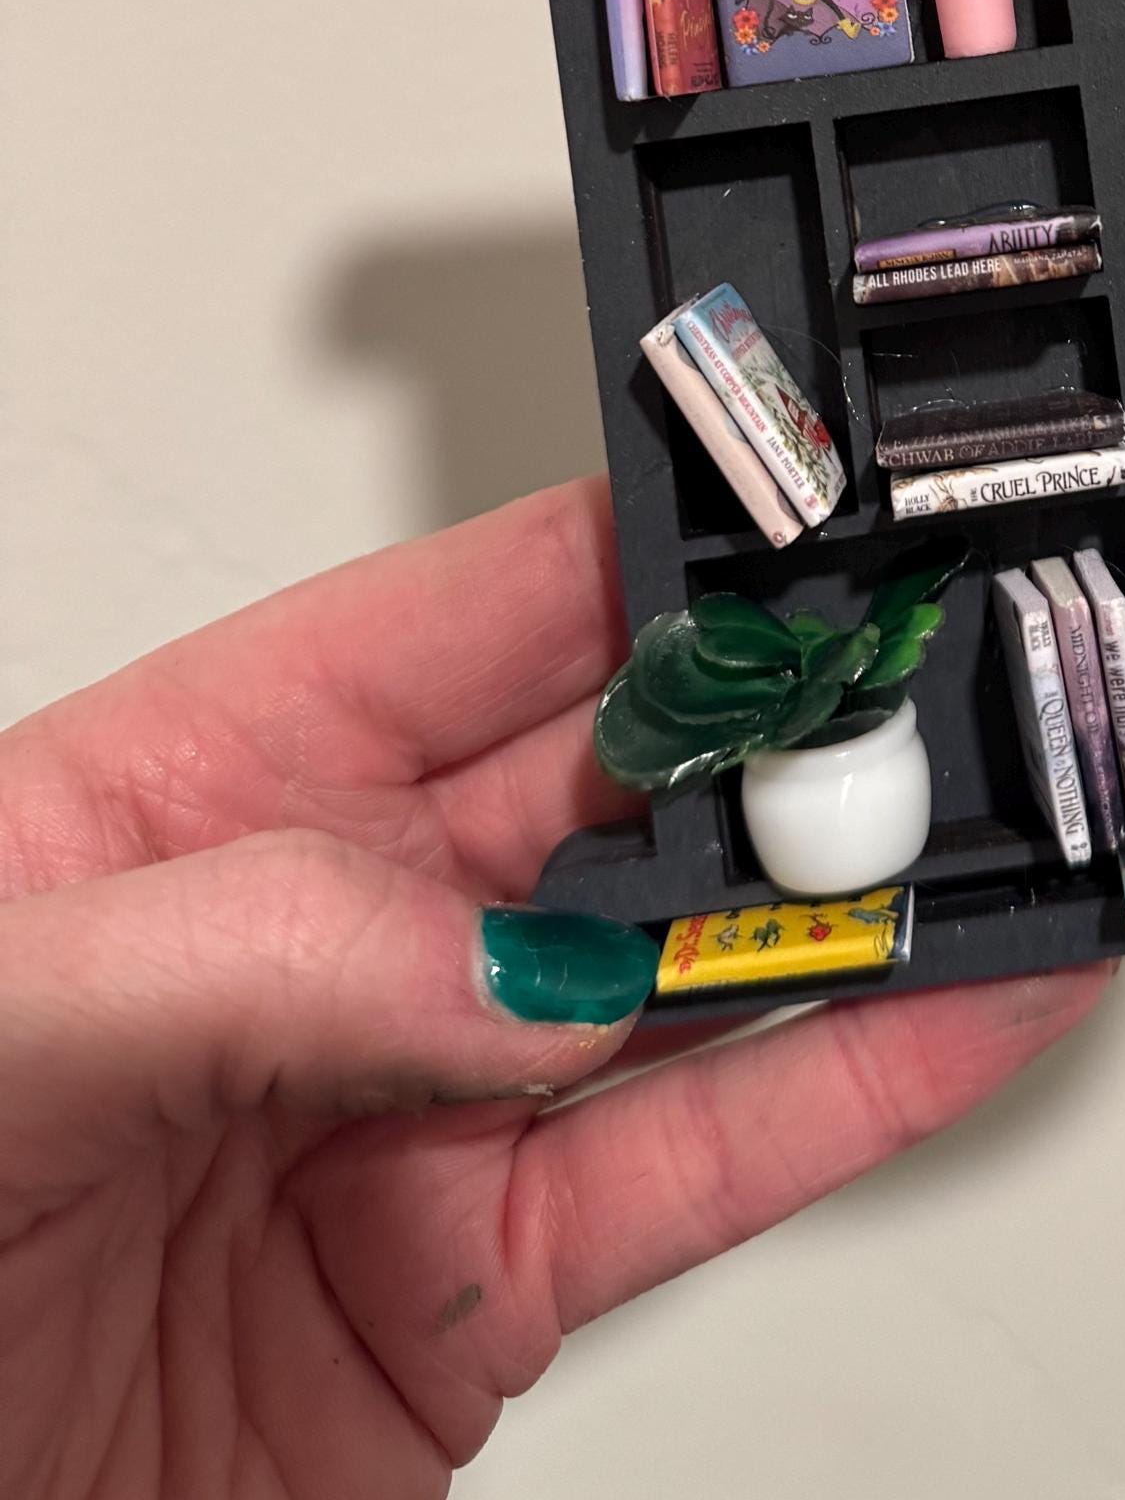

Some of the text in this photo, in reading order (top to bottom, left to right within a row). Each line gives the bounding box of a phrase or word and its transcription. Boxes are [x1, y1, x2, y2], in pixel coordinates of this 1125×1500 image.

[868, 271, 889, 289] ALL
[892, 266, 938, 286] RHODES
[940, 263, 970, 280] LEAD
[972, 258, 1002, 276] HERE
[686, 320, 718, 363] CHRISTMAS
[766, 436, 807, 489] JANE PORTER
[904, 493, 931, 506] HOLLY
[980, 478, 1037, 504] CRUEL
[1035, 465, 1102, 494] PRINCE
[904, 503, 932, 515] BLACK
[1104, 640, 1120, 662] we
[1069, 625, 1100, 736] MIDNIGHT OIL
[1038, 697, 1069, 758] QUEEN
[1051, 764, 1085, 836] NOTHING
